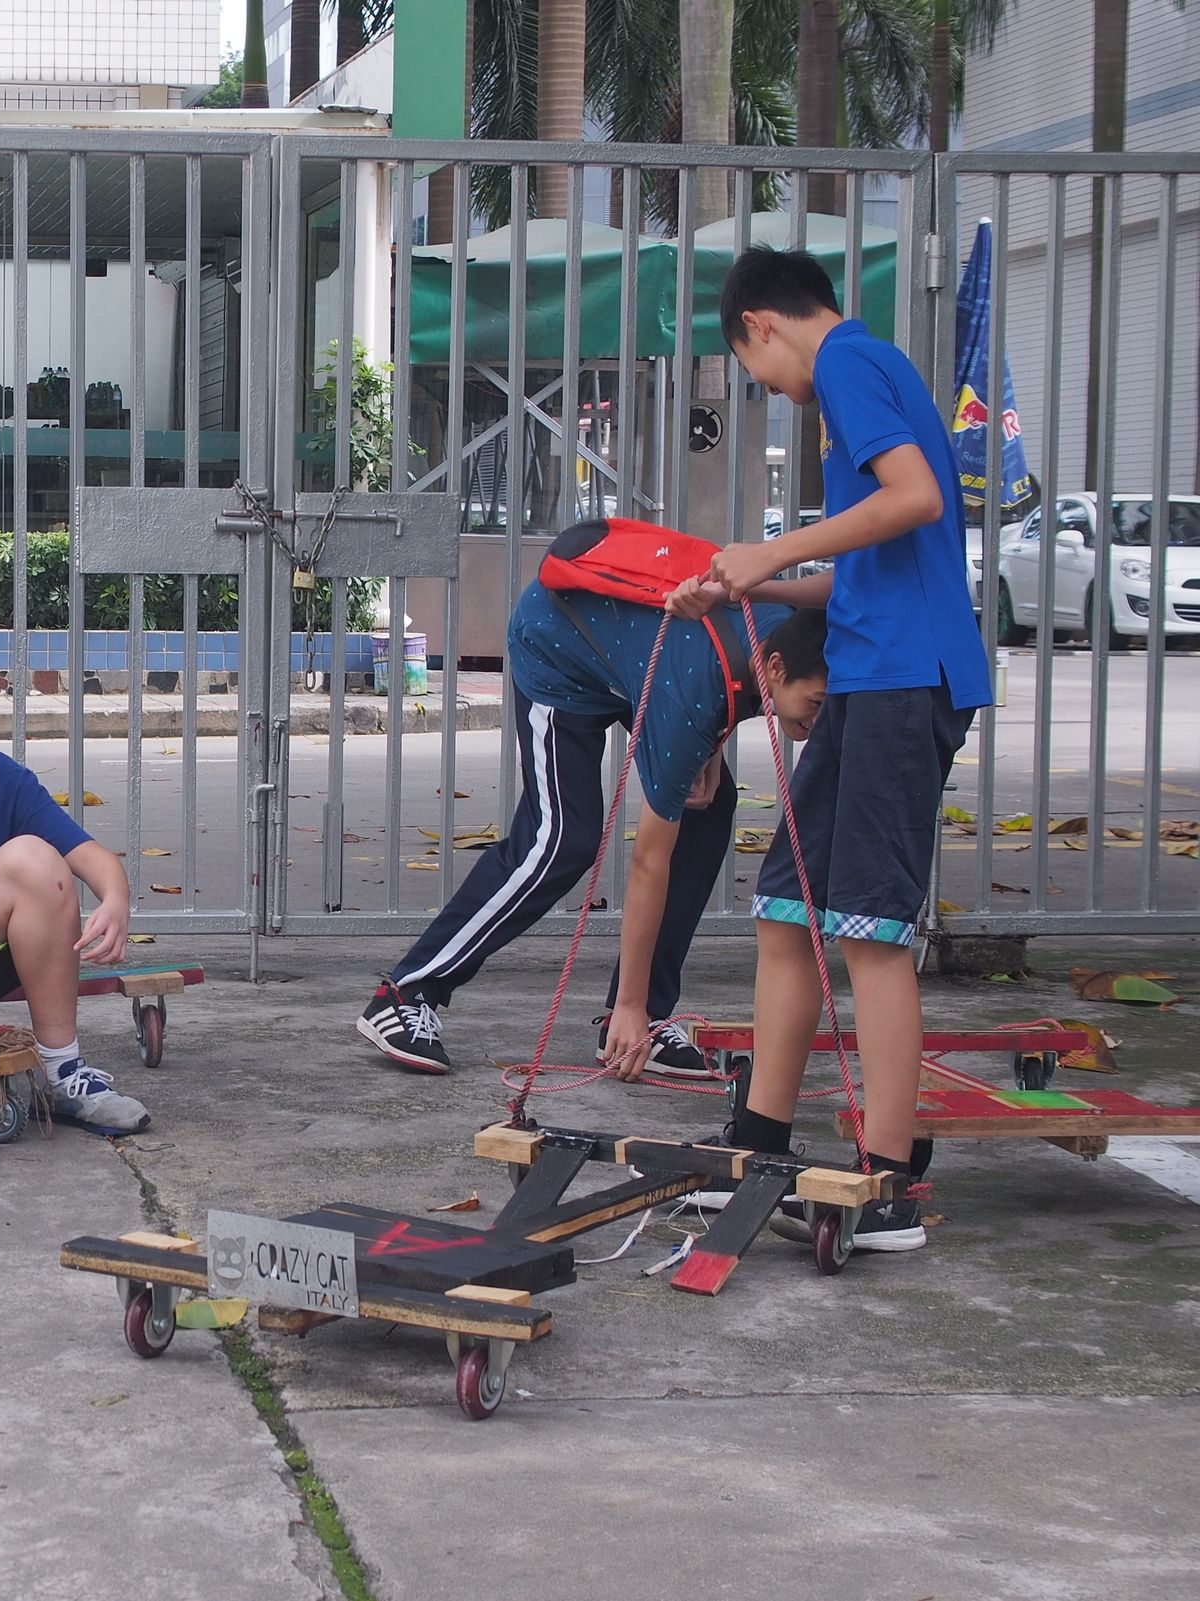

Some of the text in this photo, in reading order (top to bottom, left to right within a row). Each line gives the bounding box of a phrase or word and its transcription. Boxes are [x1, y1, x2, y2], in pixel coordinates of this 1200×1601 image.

[256, 1241, 348, 1291] CRAZY CAT
[306, 1290, 349, 1311] ITALY
